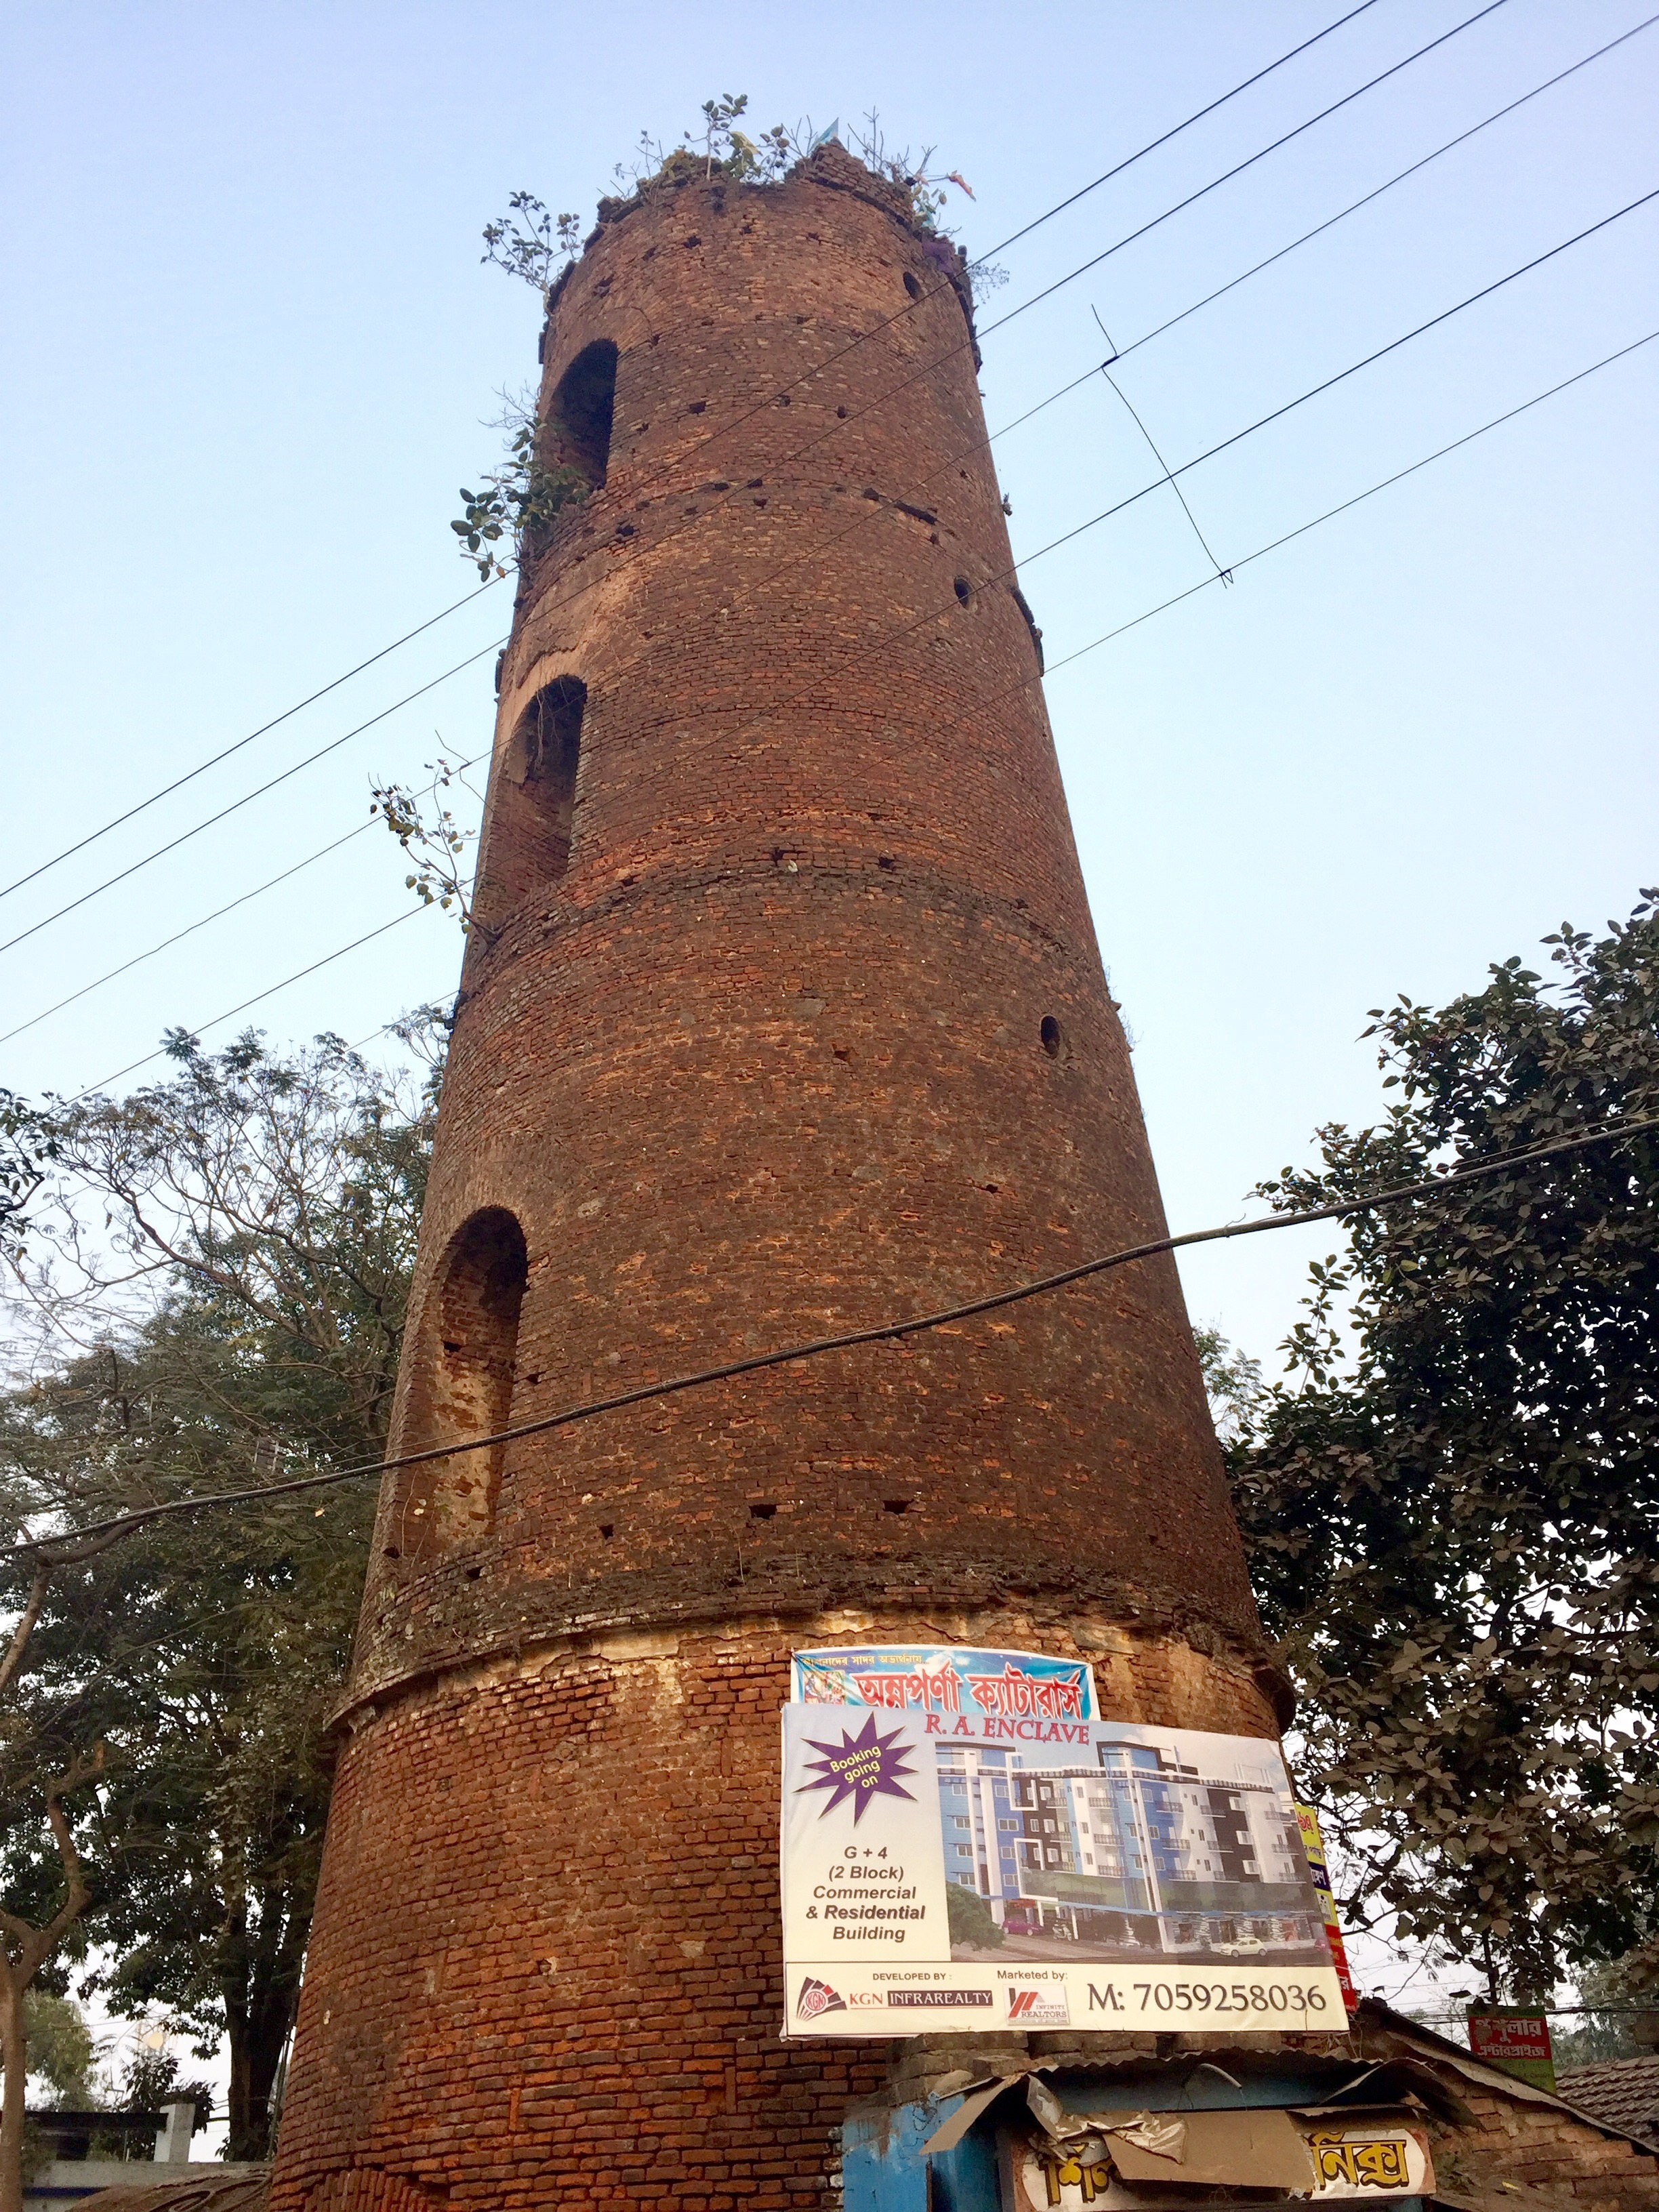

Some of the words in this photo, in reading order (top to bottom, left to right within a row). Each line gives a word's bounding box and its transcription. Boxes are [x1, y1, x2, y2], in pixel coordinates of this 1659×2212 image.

[925, 1714, 947, 1734] R.
[951, 1717, 975, 1736] A.
[983, 1717, 1090, 1745] ENCLAVE
[830, 1745, 882, 1774] Booking
[844, 1759, 882, 1783] going
[861, 1776, 879, 1788] on
[844, 1846, 857, 1859] G
[863, 1848, 873, 1858] +
[878, 1846, 888, 1859] 4
[829, 1866, 844, 1882] (2
[850, 1866, 905, 1882] Block)
[813, 1886, 916, 1900] Commercial
[806, 1906, 818, 1919] &
[824, 1905, 926, 1920] Residential
[833, 1927, 905, 1942] Building
[873, 1973, 931, 1981] DEVELOPED
[997, 1971, 1048, 1980] Marketed
[1052, 1971, 1068, 1982] by:
[806, 1992, 825, 2010] KGN
[849, 1993, 883, 2005] KGN
[890, 1992, 991, 2005] INFRAREALTY
[1087, 1983, 1125, 2010] M:
[1133, 1984, 1326, 2011] 7059258036
